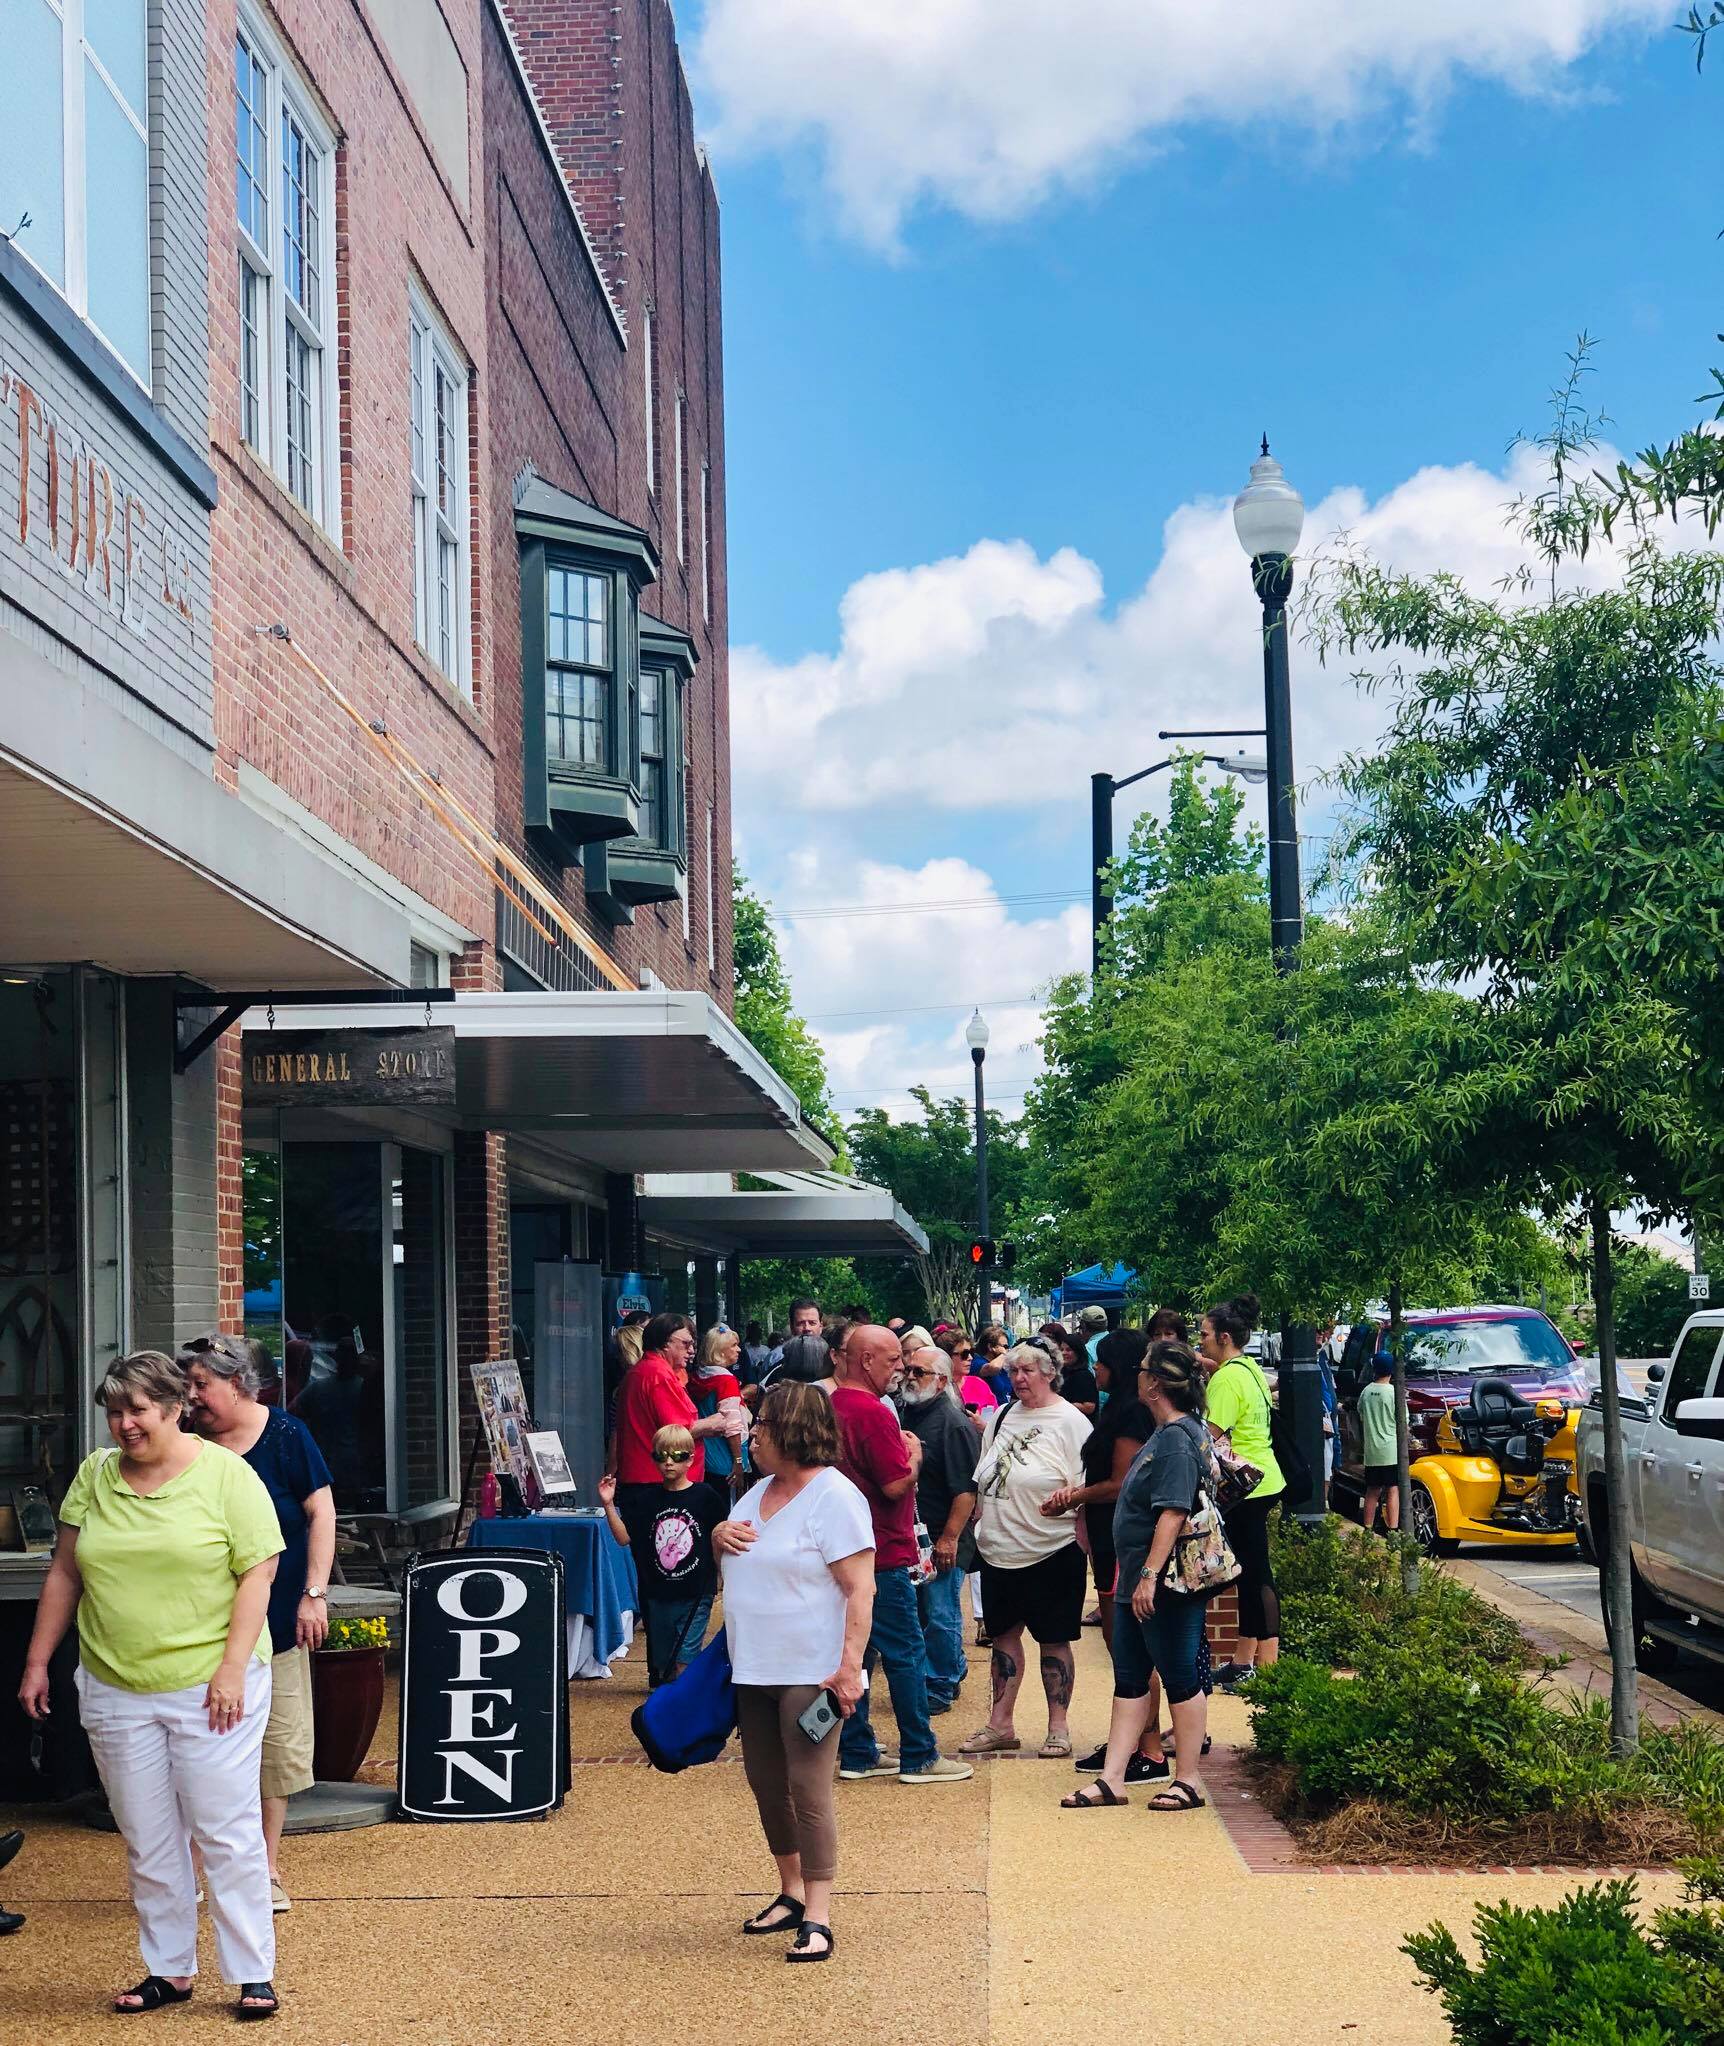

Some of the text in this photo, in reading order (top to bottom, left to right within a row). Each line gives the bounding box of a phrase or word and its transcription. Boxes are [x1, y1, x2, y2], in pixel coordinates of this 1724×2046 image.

[252, 1052, 350, 1083] GENERAL
[1691, 1287, 1707, 1296] 30
[622, 1298, 647, 1311] Elvis
[681, 1508, 695, 1521] Fan
[433, 1569, 527, 1804] OPEN
